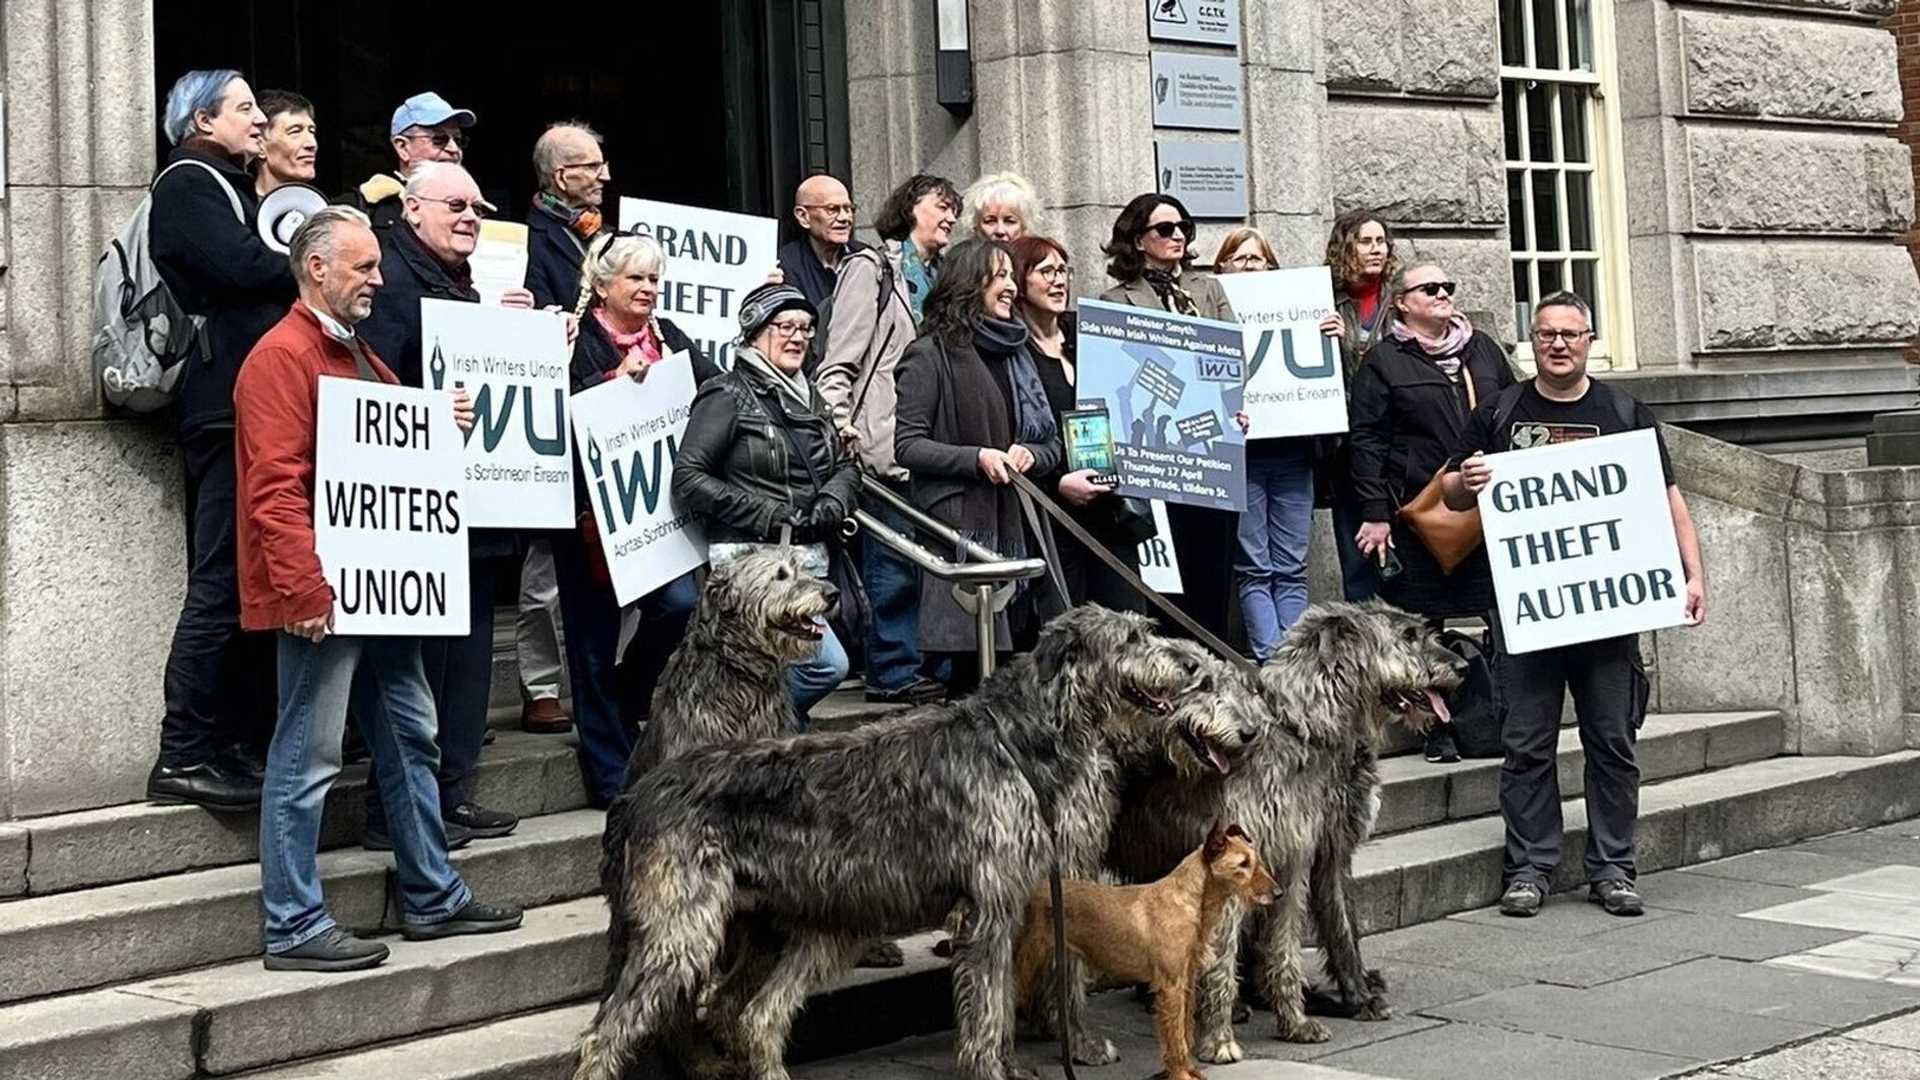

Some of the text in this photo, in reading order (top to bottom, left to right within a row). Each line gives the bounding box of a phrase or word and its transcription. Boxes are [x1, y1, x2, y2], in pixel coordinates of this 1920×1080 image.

[657, 280, 736, 318] HEFT
[1080, 320, 1242, 356] Side With Irish Writers Against Meta
[1126, 315, 1198, 336] Minister Smyth:
[453, 353, 564, 380] Irish Writers Union
[355, 397, 430, 451] IRISH
[605, 403, 691, 453] Irish Writers Unio
[1122, 460, 1203, 481] Thursday 17 April
[1128, 447, 1138, 458] To
[1140, 449, 1176, 463] Present
[1177, 454, 1195, 465] Our
[1196, 457, 1233, 472] Petition
[325, 479, 461, 535] WRITERS
[1127, 475, 1150, 488] Dept
[1152, 477, 1182, 492] Trade,
[1182, 482, 1215, 497] Kildare
[1215, 486, 1229, 499] St.
[1491, 463, 1629, 513] GRAND
[1499, 518, 1623, 569] THEFT
[340, 567, 446, 617] UNION
[1516, 568, 1677, 626] AUTHOR
